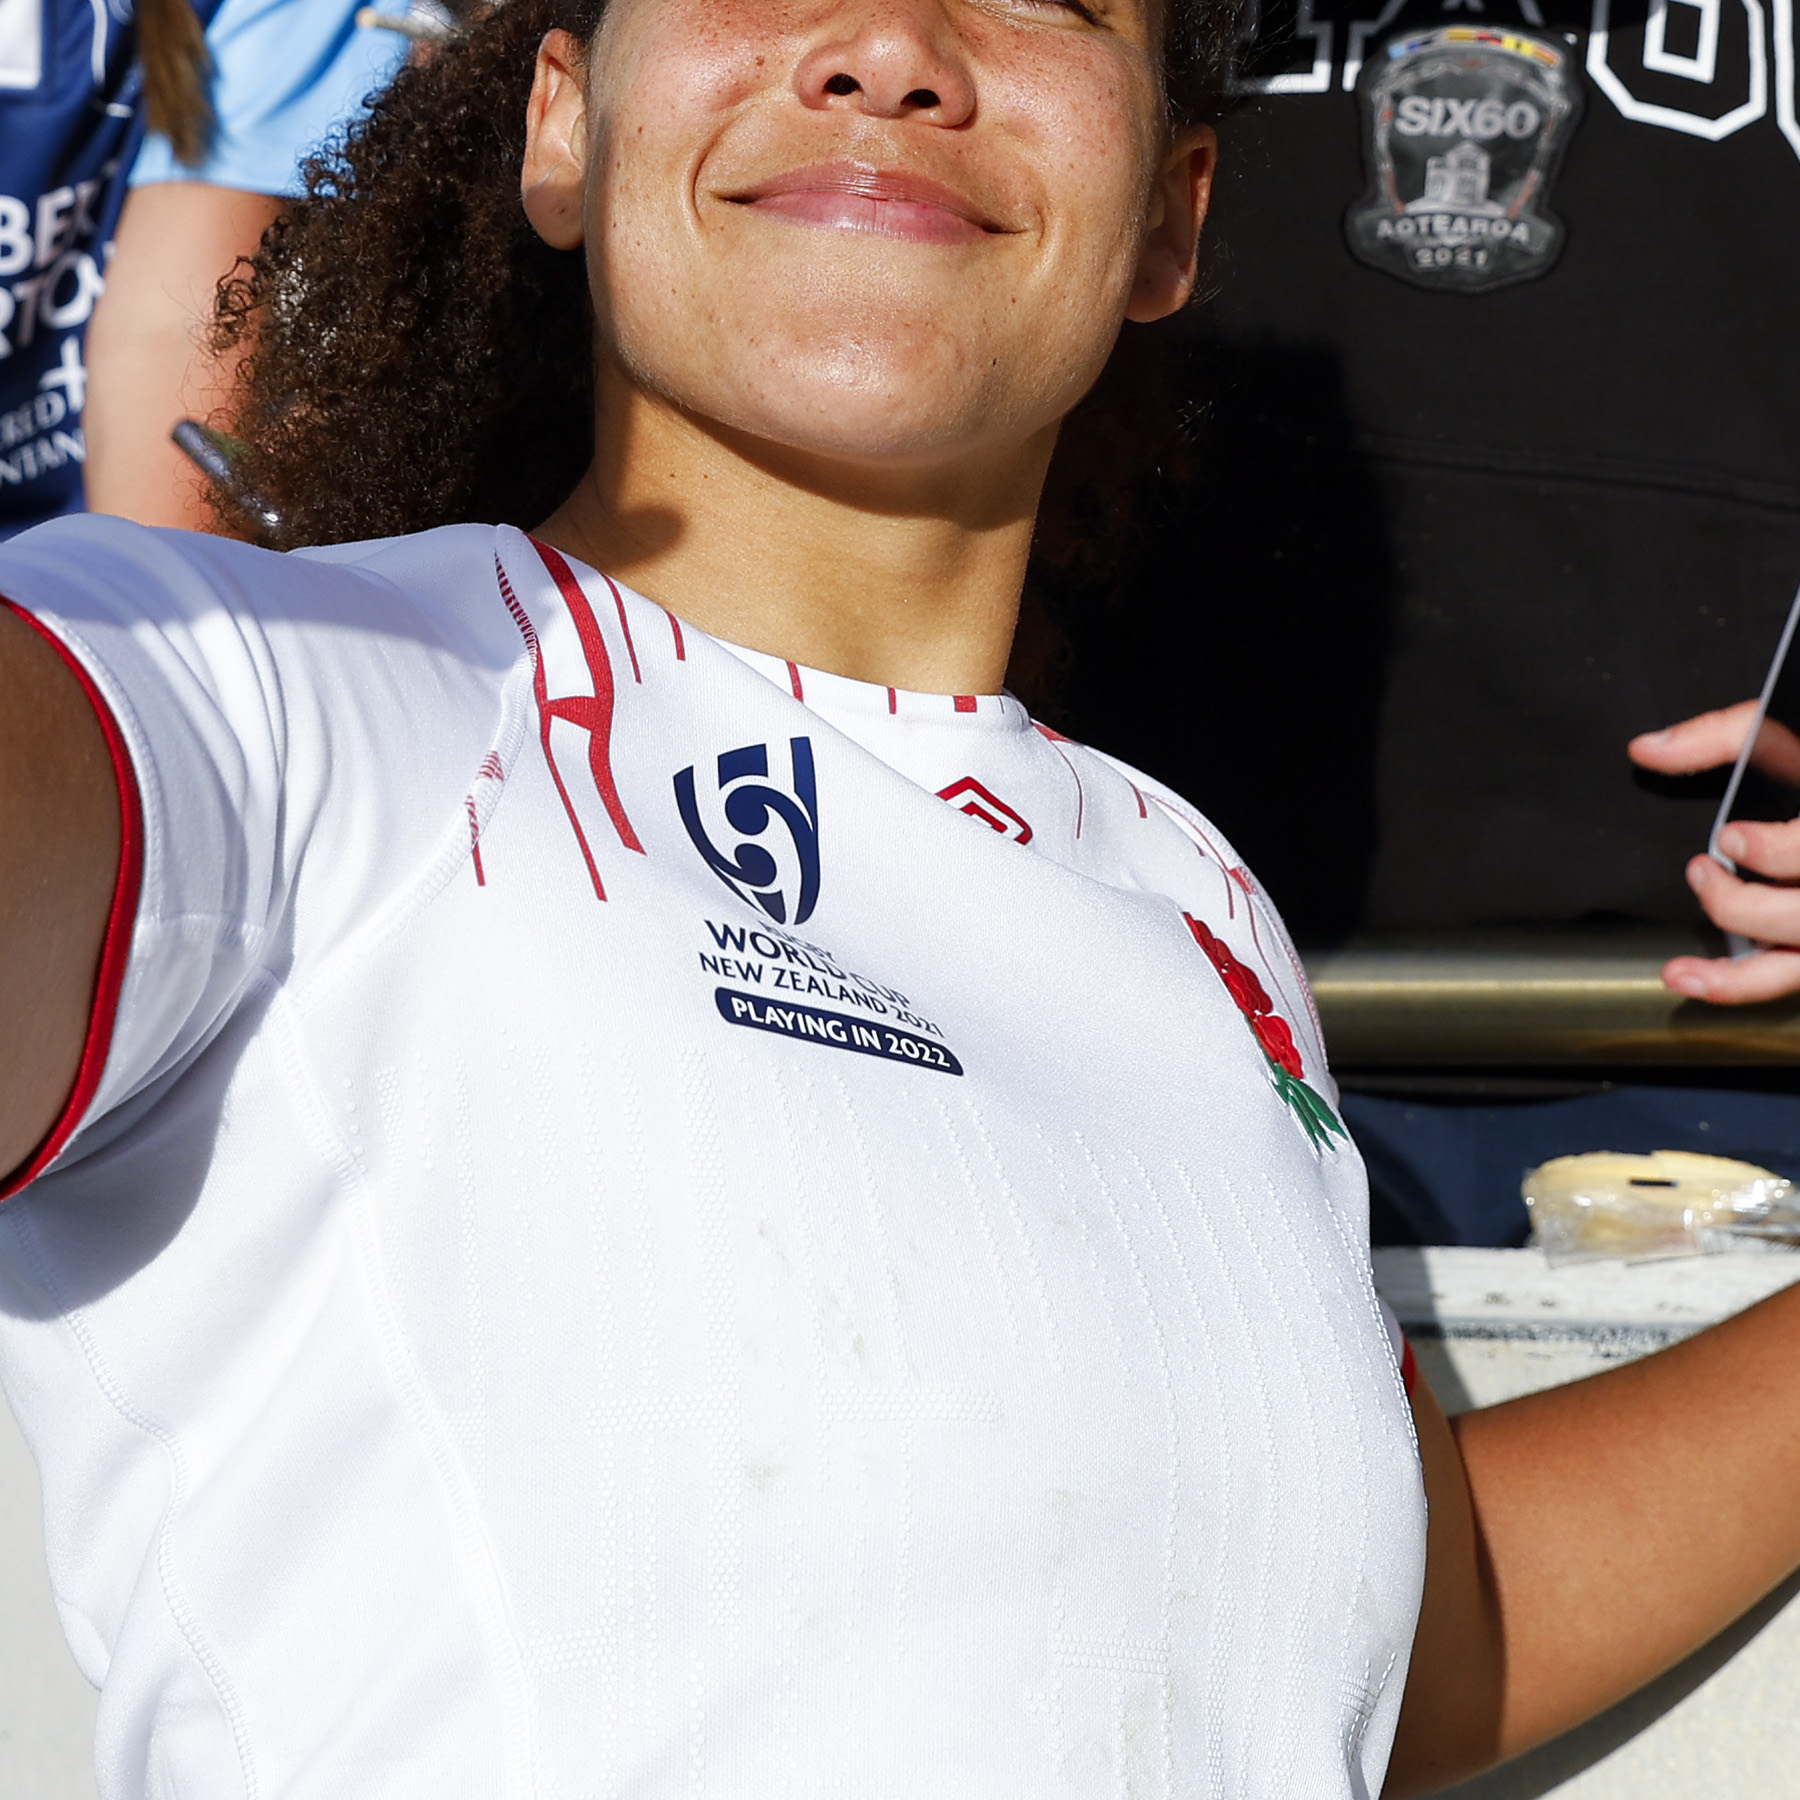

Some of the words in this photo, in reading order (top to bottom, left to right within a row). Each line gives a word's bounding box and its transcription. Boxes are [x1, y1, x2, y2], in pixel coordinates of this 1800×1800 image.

[1394, 96, 1540, 140] SIX60
[1376, 215, 1531, 244] AOTEAROA
[699, 952, 764, 984] NEW
[771, 966, 888, 1015] ZEALAND
[890, 1004, 945, 1039] 2021
[704, 919, 848, 980] WORLD
[849, 972, 911, 1007] CUP
[730, 996, 848, 1043] PLAYING
[851, 1024, 882, 1051] IN
[884, 1033, 951, 1068] 2022
